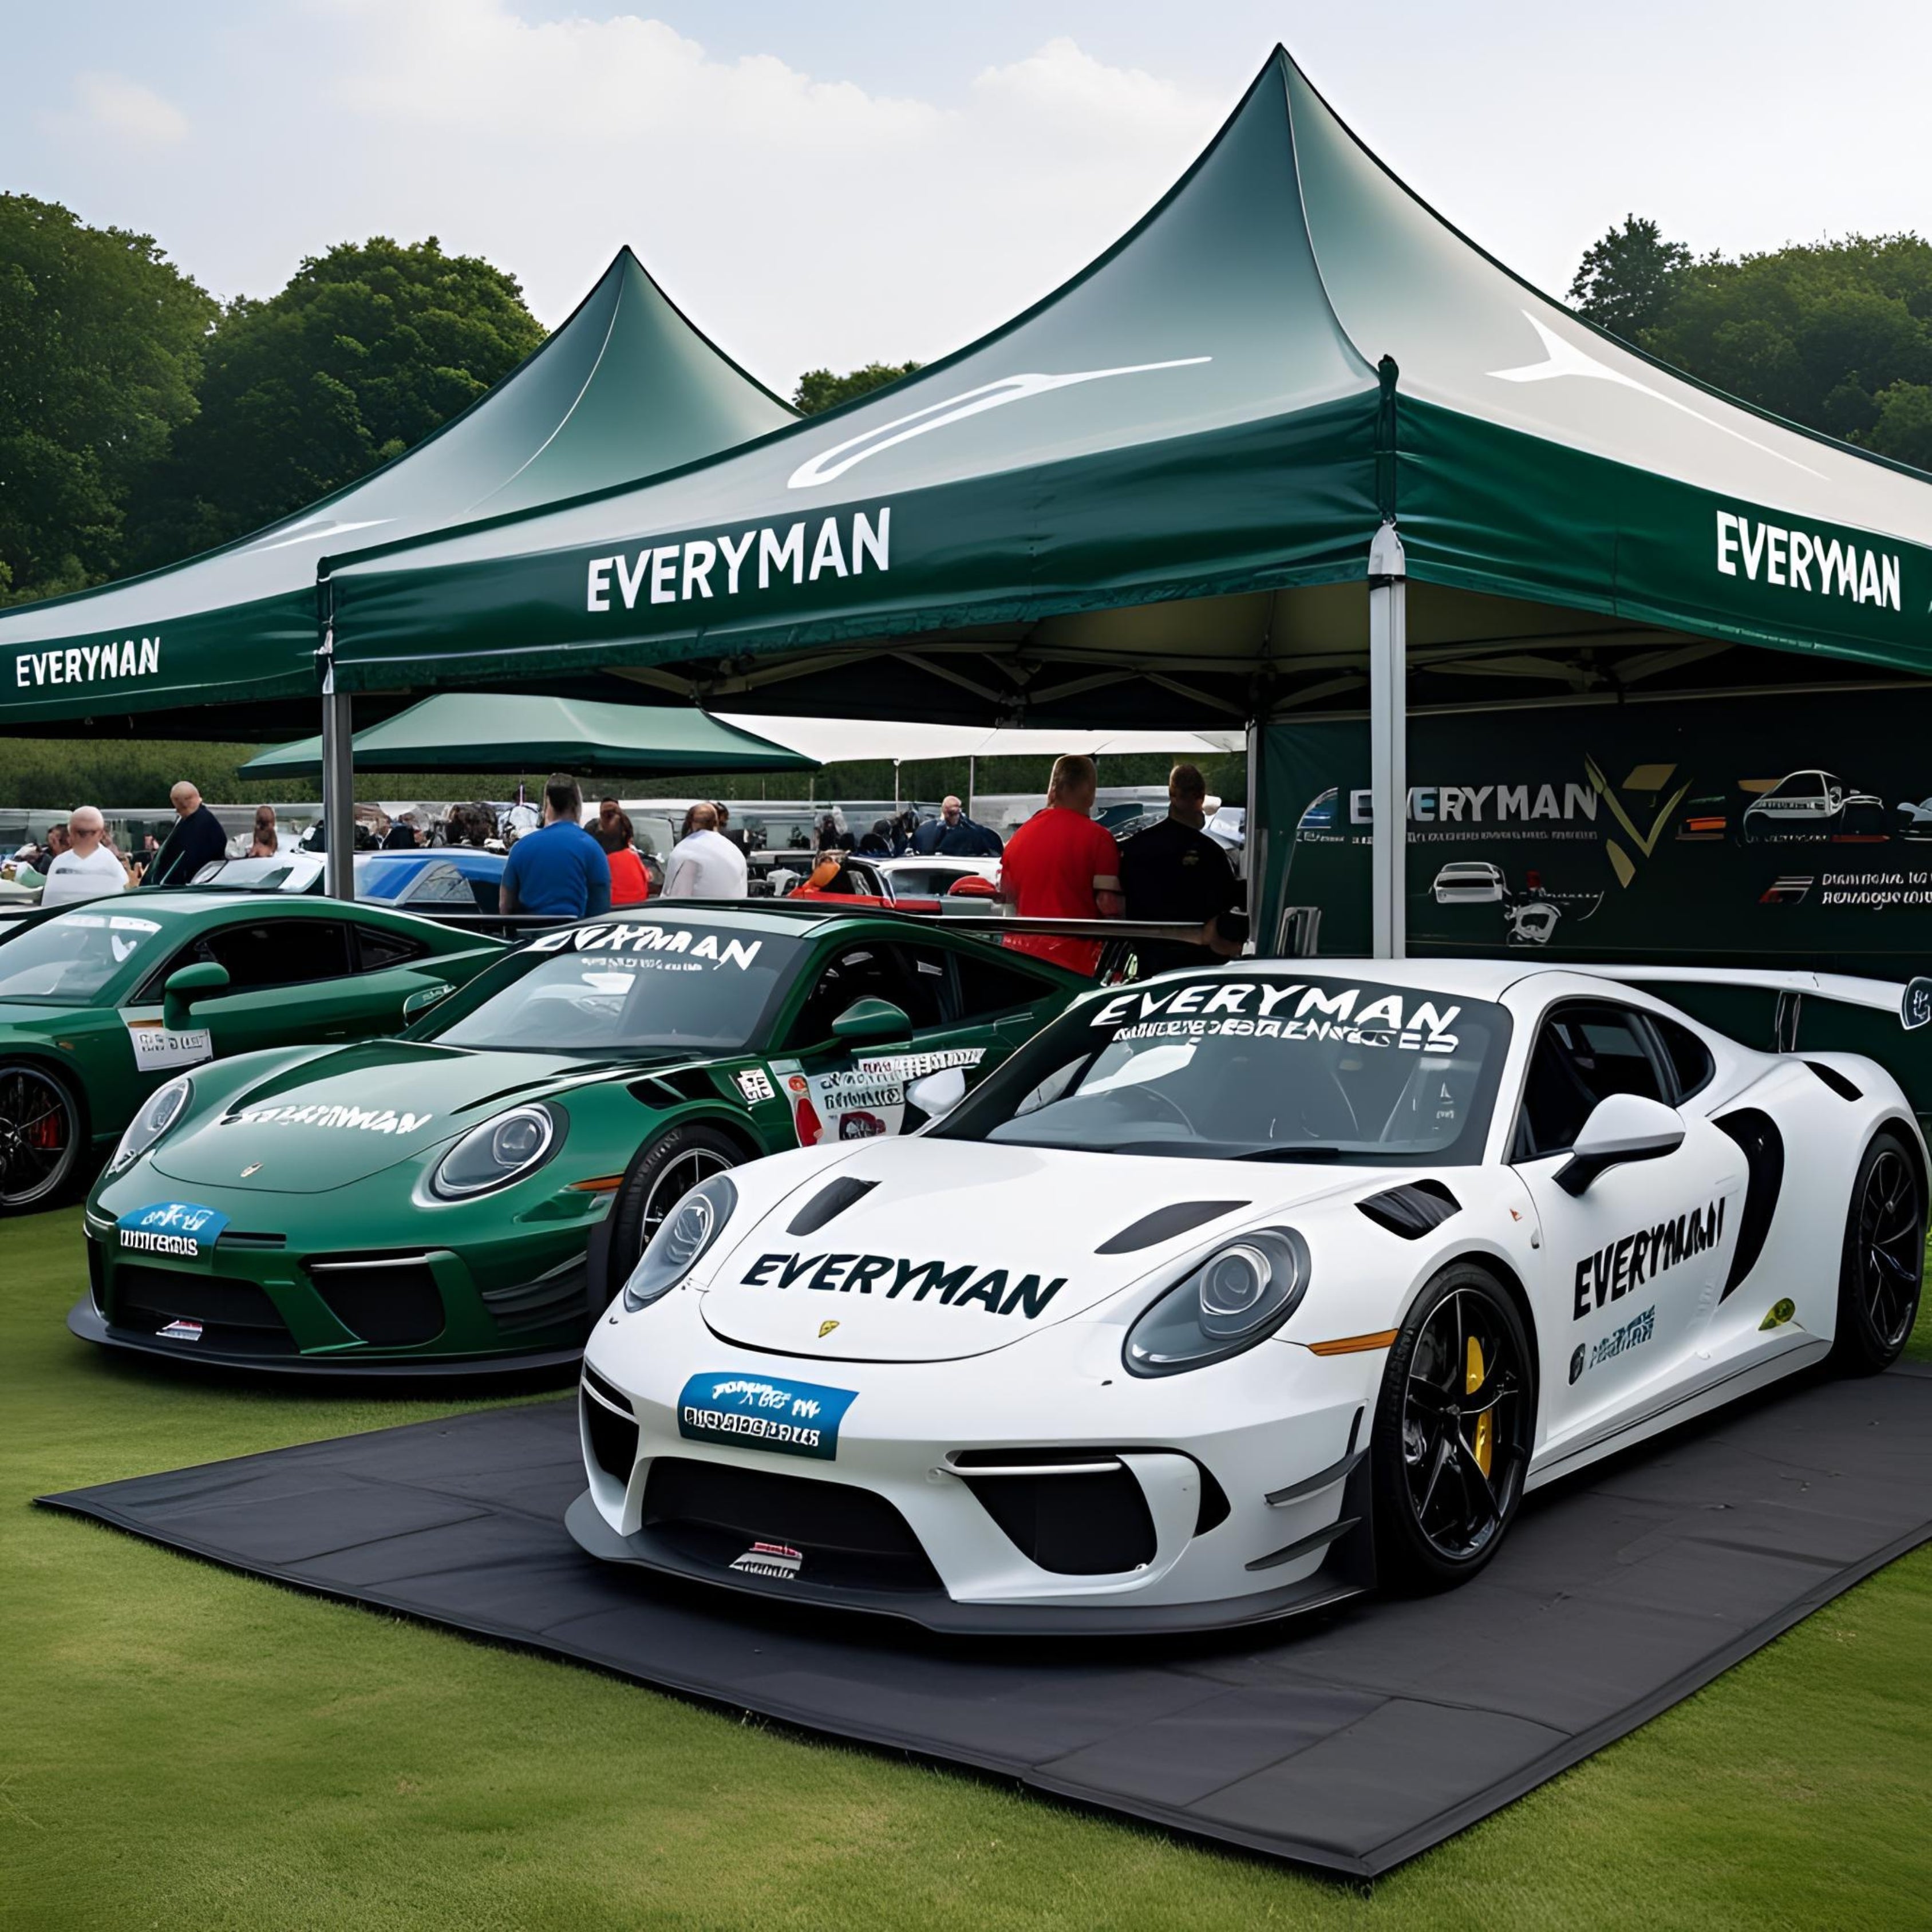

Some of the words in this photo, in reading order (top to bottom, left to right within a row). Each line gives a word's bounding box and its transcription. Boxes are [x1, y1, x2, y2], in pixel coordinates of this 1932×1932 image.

[587, 507, 891, 612] EVERYMAN
[1717, 510, 1901, 611] EVERYMAN
[1350, 783, 1598, 824] EERYMAN
[1090, 984, 1461, 1035] EVERYMAN
[740, 1253, 1068, 1319] EVERYMAN
